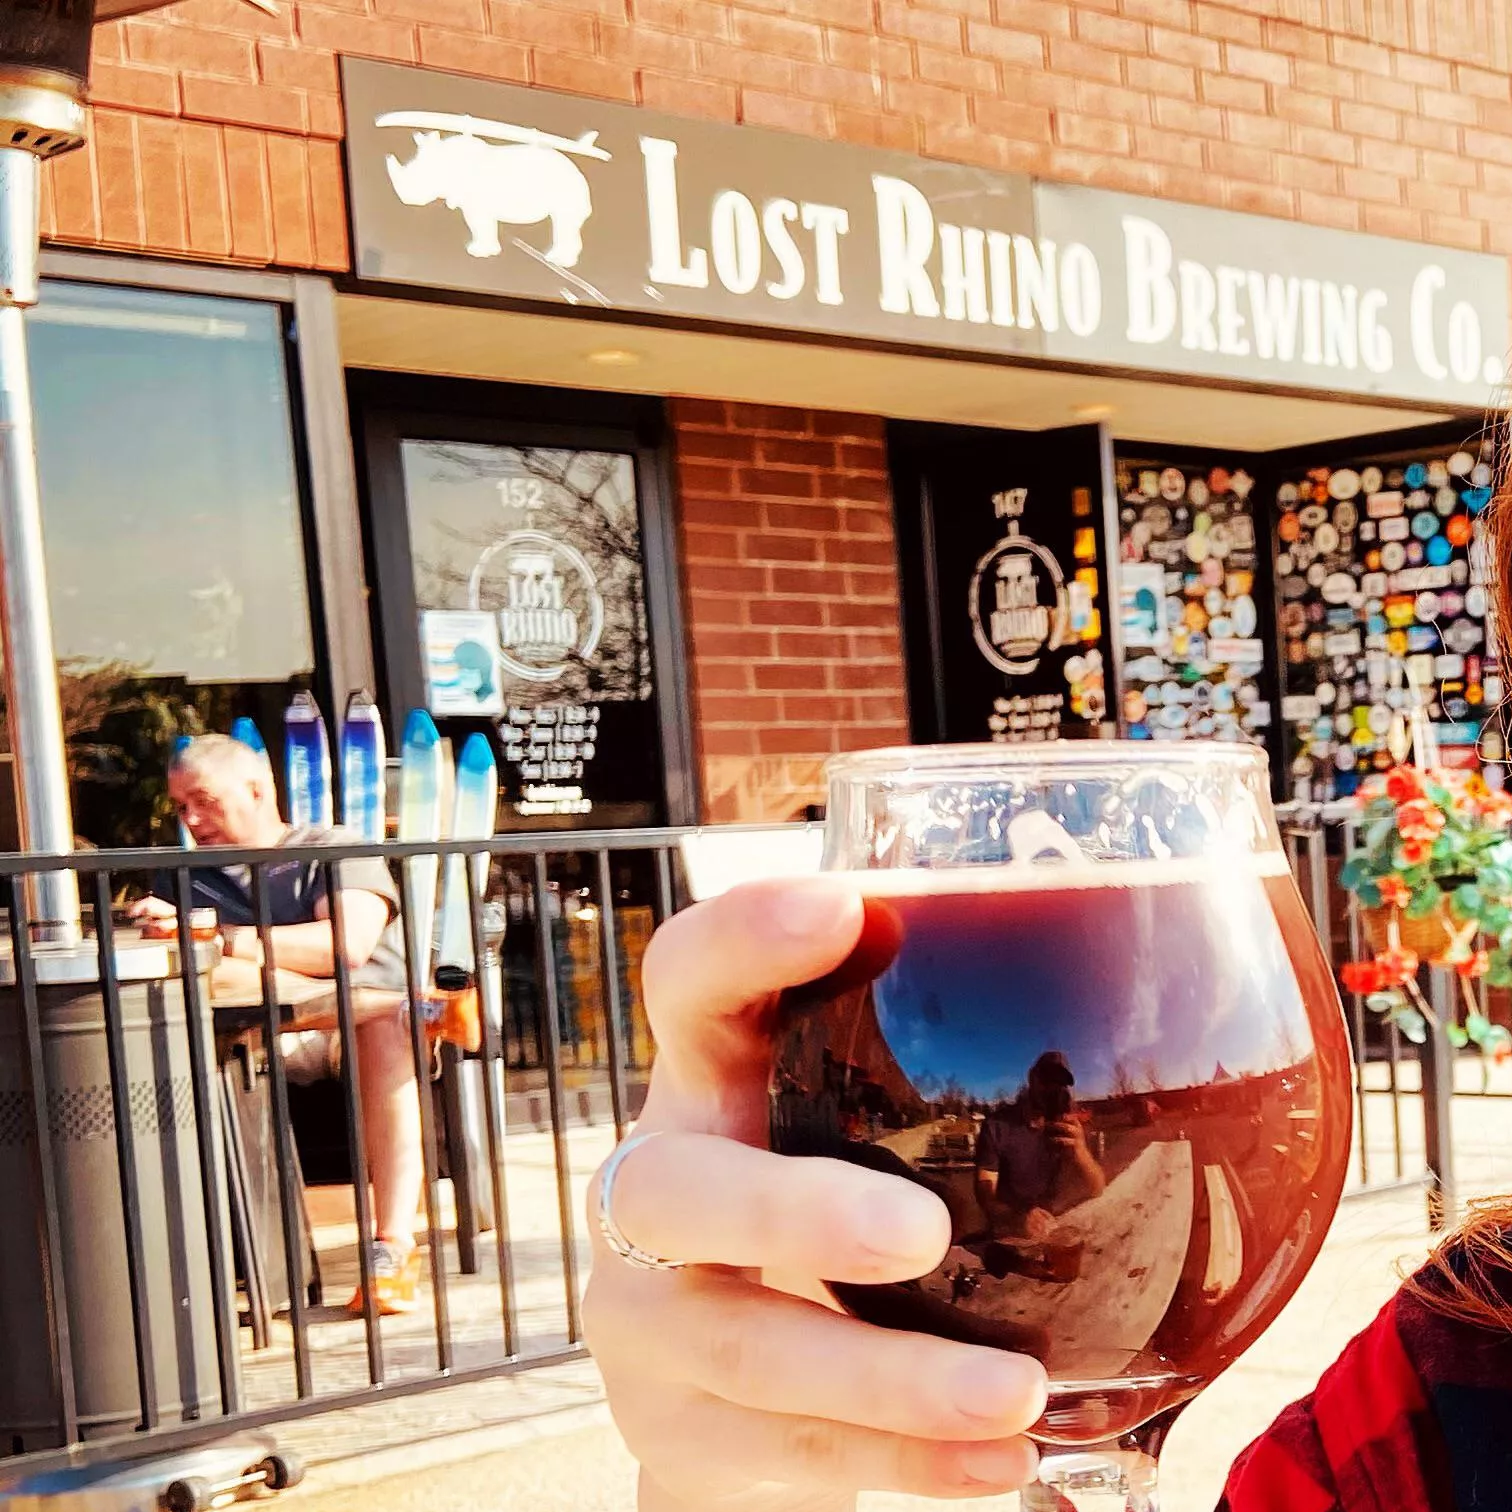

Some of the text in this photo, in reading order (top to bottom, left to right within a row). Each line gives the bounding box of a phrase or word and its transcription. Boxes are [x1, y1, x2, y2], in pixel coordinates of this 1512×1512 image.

[639, 135, 1503, 385] LOST RHINO BREWING CO.
[495, 477, 546, 510] 152
